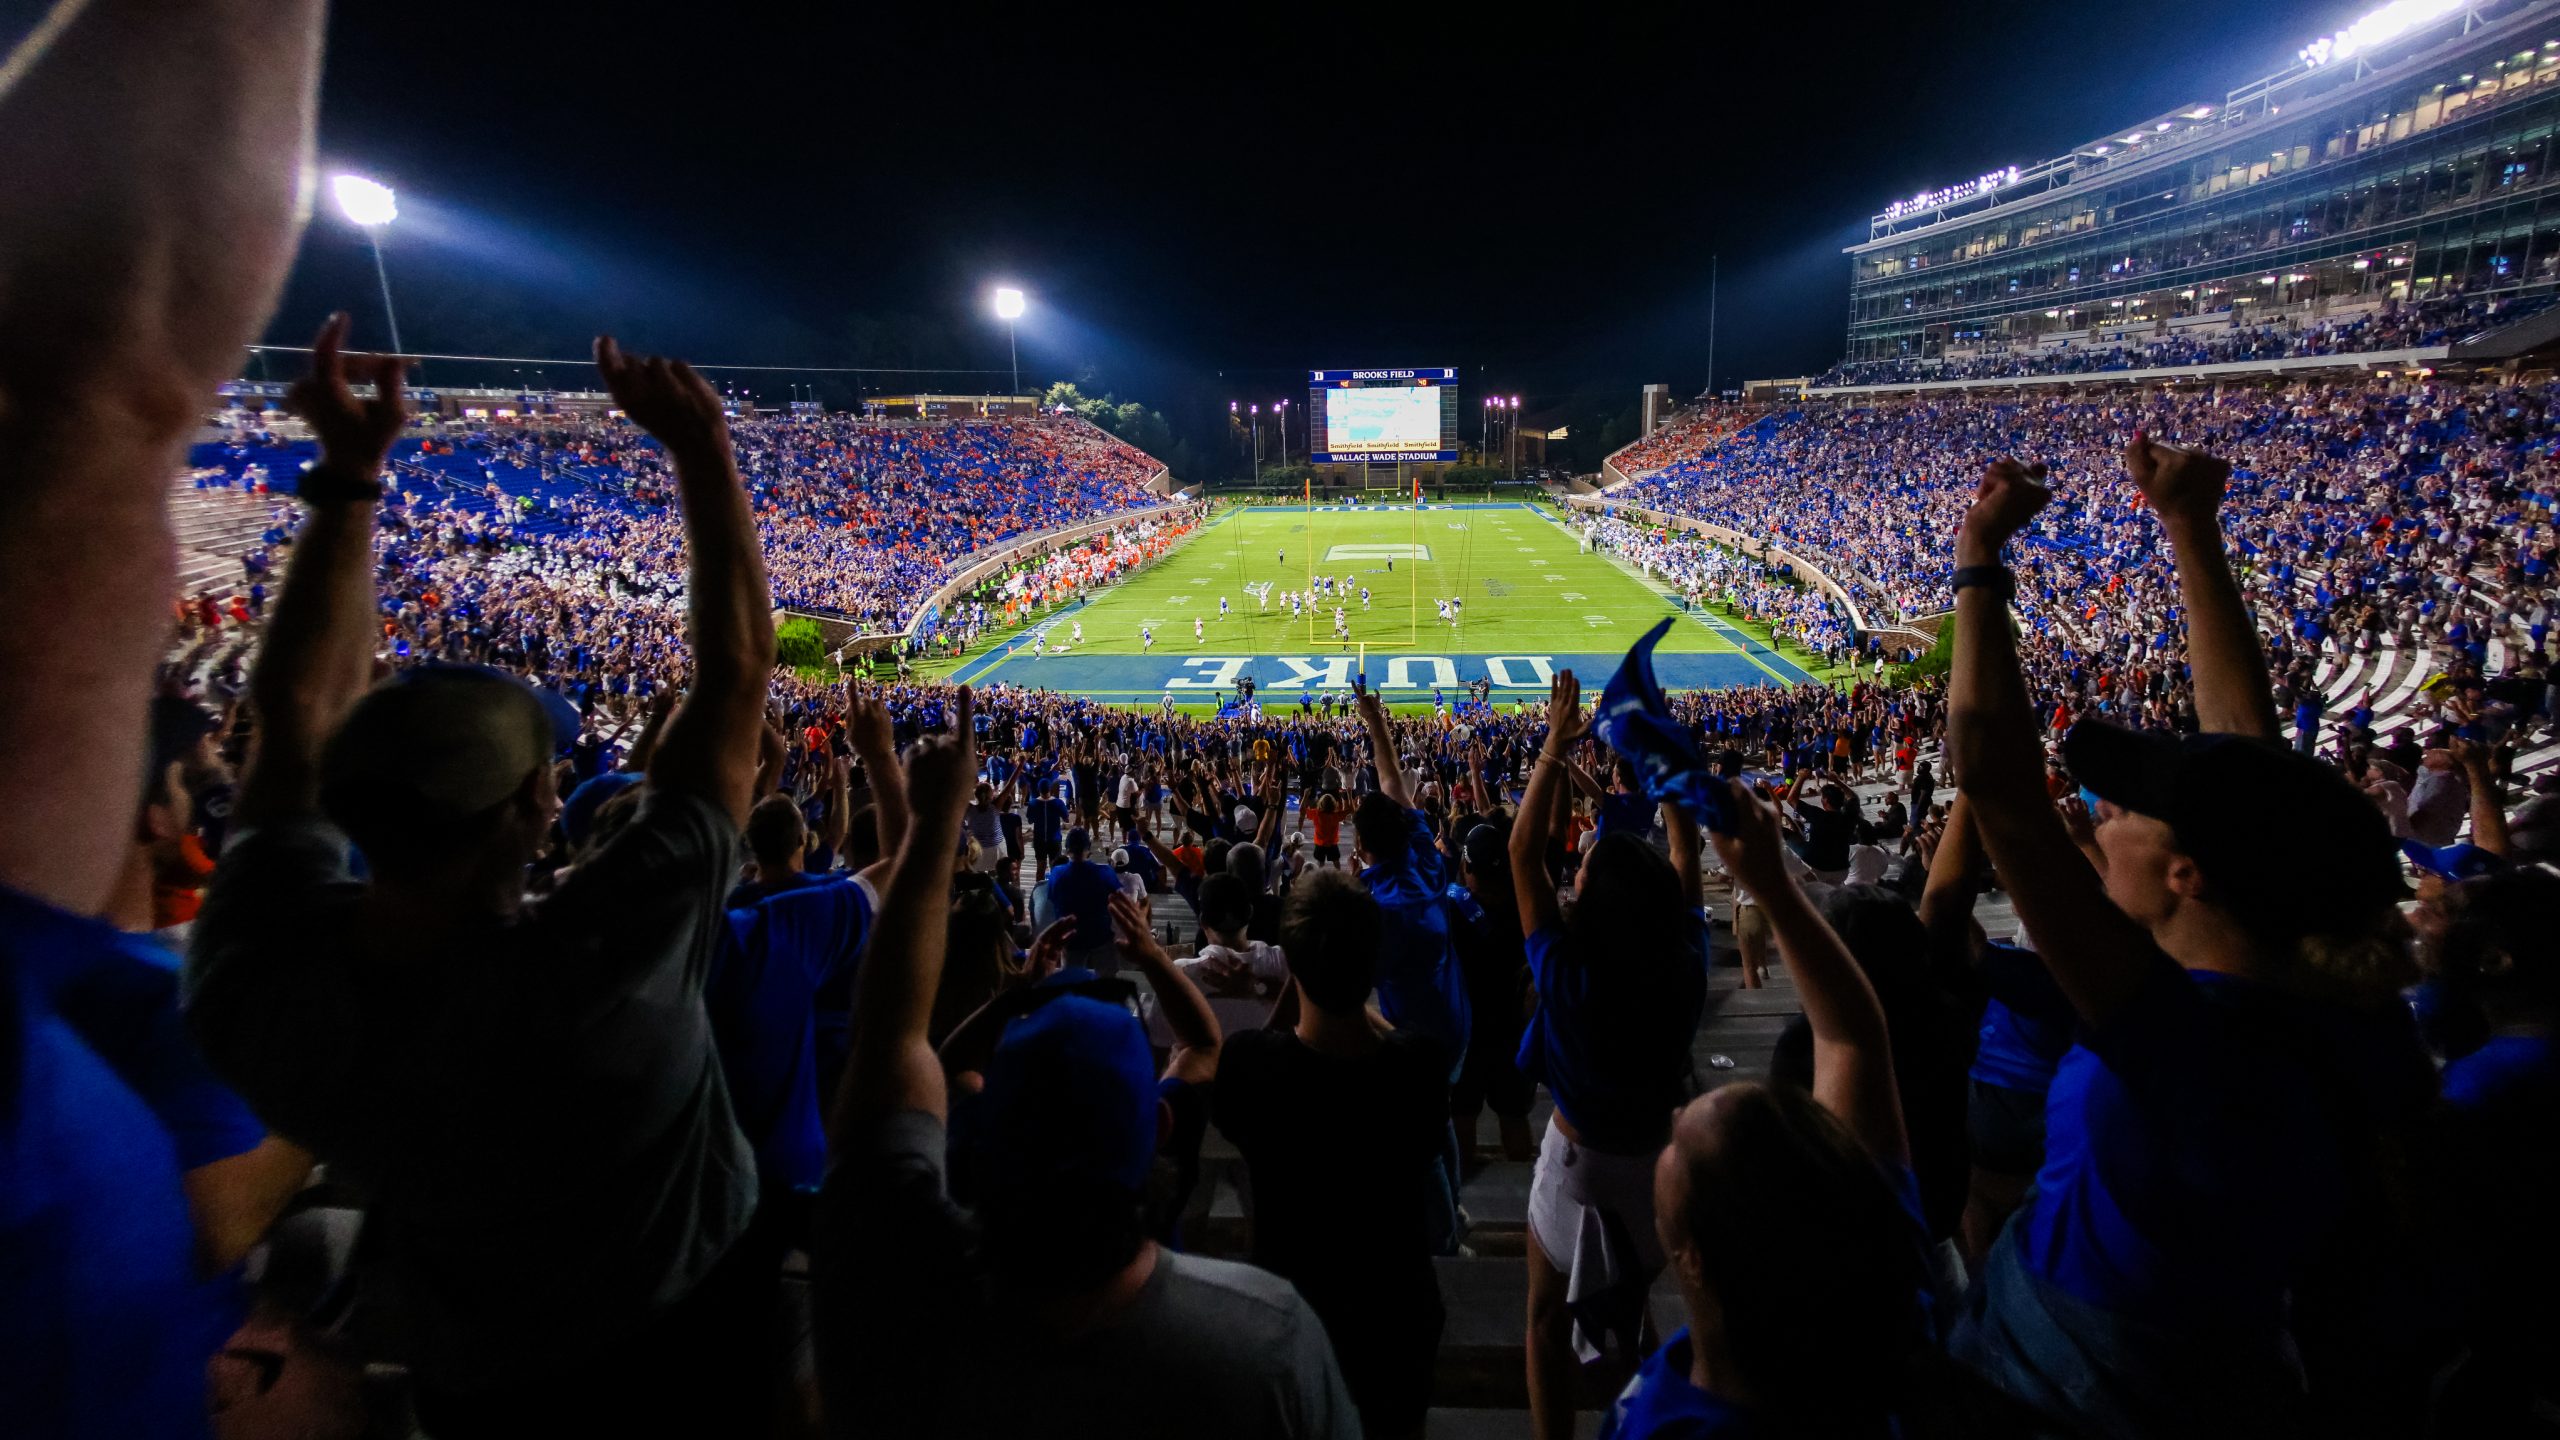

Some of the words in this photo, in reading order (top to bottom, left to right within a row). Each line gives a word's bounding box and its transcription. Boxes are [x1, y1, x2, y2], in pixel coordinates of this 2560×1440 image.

[1353, 371, 1388, 379] BROOKS
[1390, 370, 1415, 378] FIELD
[1331, 453, 1370, 462] WALLACE
[1372, 453, 1397, 461] WADE
[1398, 452, 1438, 461] STADIUM
[1165, 656, 1557, 688] DUKE
